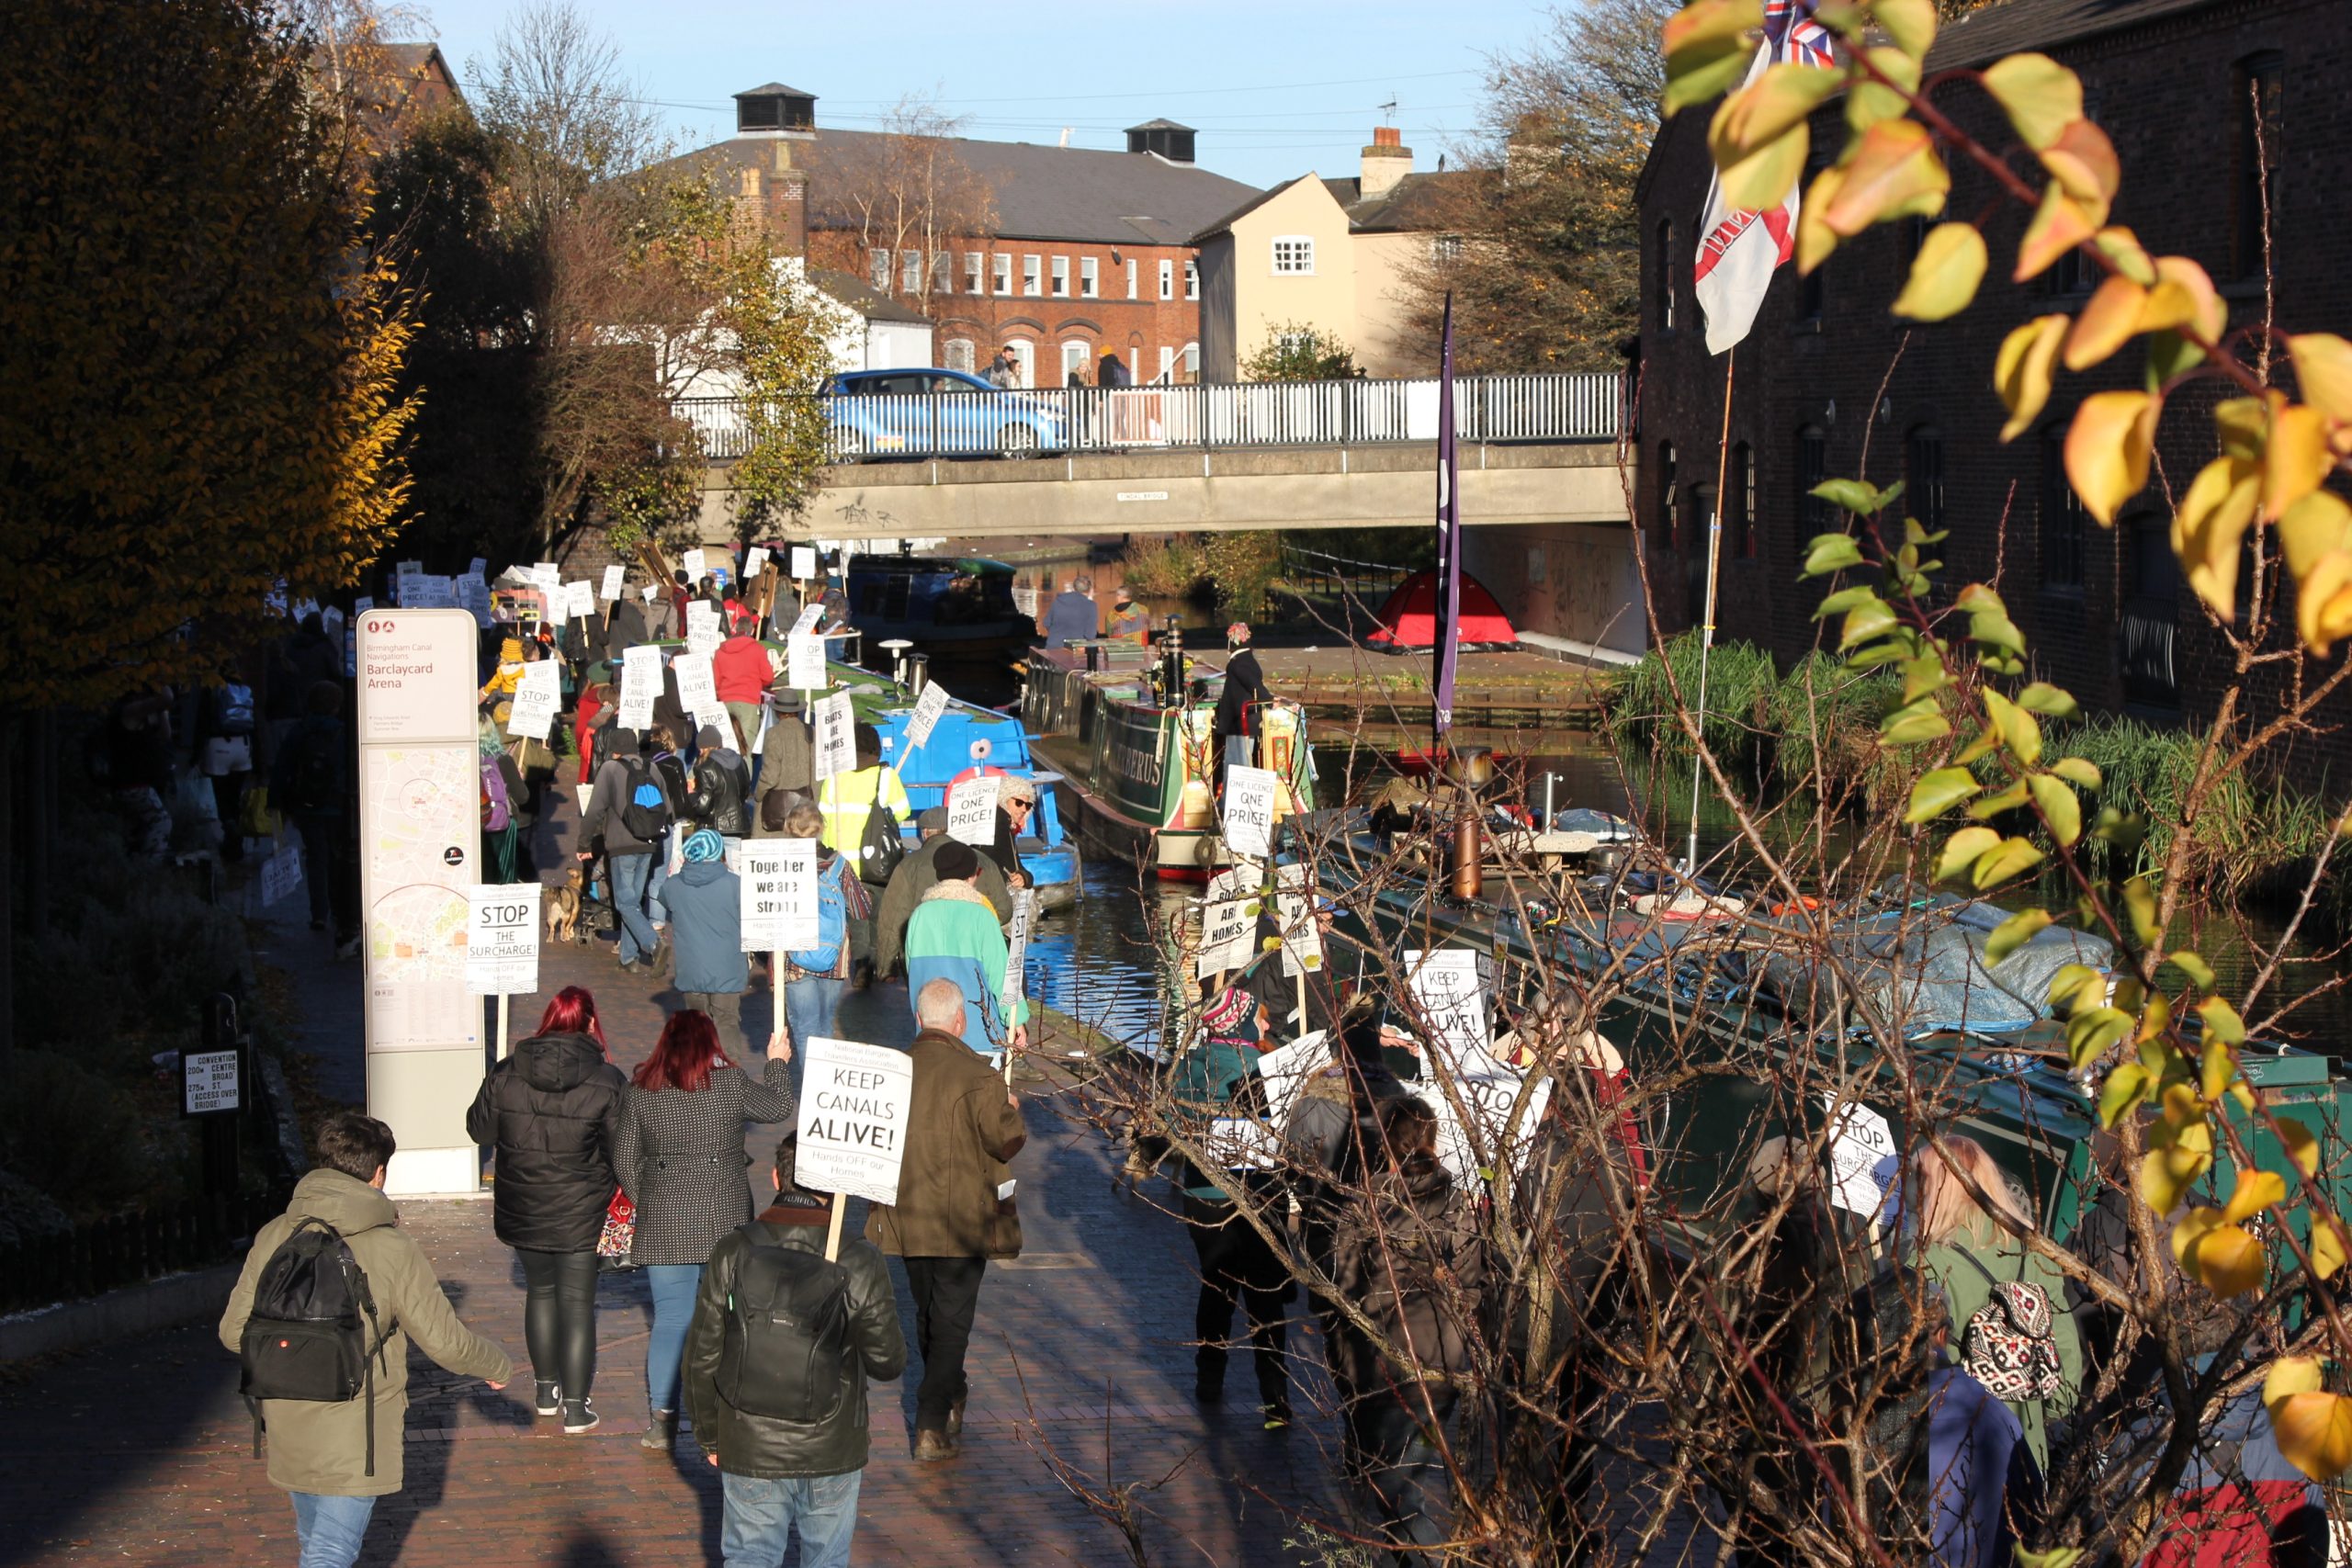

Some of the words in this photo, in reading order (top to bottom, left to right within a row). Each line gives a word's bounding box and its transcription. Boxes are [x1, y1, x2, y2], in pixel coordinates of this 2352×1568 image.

[367, 644, 411, 652] Birmingham
[412, 643, 433, 651] Canal
[367, 653, 409, 661] Navigations
[630, 656, 655, 667] STOP
[367, 662, 434, 676] Barclaycard
[368, 678, 402, 689] Arena
[630, 678, 645, 686] KEEP
[683, 681, 711, 693] ALIVE!
[522, 690, 550, 702] STOP
[623, 699, 650, 709] ALIVE!
[922, 700, 936, 715] ONE
[700, 713, 724, 726] STOP
[913, 708, 934, 730] PRICE!
[951, 791, 965, 799] ONE
[967, 787, 996, 796] LICENCE
[1229, 780, 1246, 789] ONE
[1247, 782, 1273, 794] LICENCE
[961, 796, 984, 810] ONE
[1240, 792, 1263, 807] ONE
[951, 808, 992, 828] PRICE!
[1228, 808, 1269, 827] PRICE!
[749, 860, 805, 874] Togeher
[756, 881, 774, 893] we
[481, 905, 529, 924] STOP
[496, 931, 515, 942] THE
[1211, 921, 1243, 942] HOMES
[469, 944, 537, 957] SURCHARGE!
[1428, 971, 1459, 986] KEEP
[834, 1043, 864, 1055] National
[198, 1054, 236, 1065] CONVENTION
[859, 1057, 899, 1070] Association
[211, 1063, 235, 1072] CENTRE
[212, 1072, 233, 1080] BROAD
[833, 1067, 885, 1090] KEEP
[191, 1090, 219, 1101] (ACCESS
[220, 1089, 237, 1098] OVER
[1465, 1079, 1514, 1111] STO
[195, 1100, 220, 1109] BRIDGE)
[817, 1091, 895, 1120] CANALS
[807, 1117, 895, 1151] ALIVE!
[1849, 1118, 1884, 1148] TOP
[812, 1150, 843, 1164] Hands
[846, 1155, 868, 1166] OFF
[870, 1161, 885, 1170] our
[1854, 1145, 1873, 1162] THE
[831, 1166, 865, 1178] Homes
